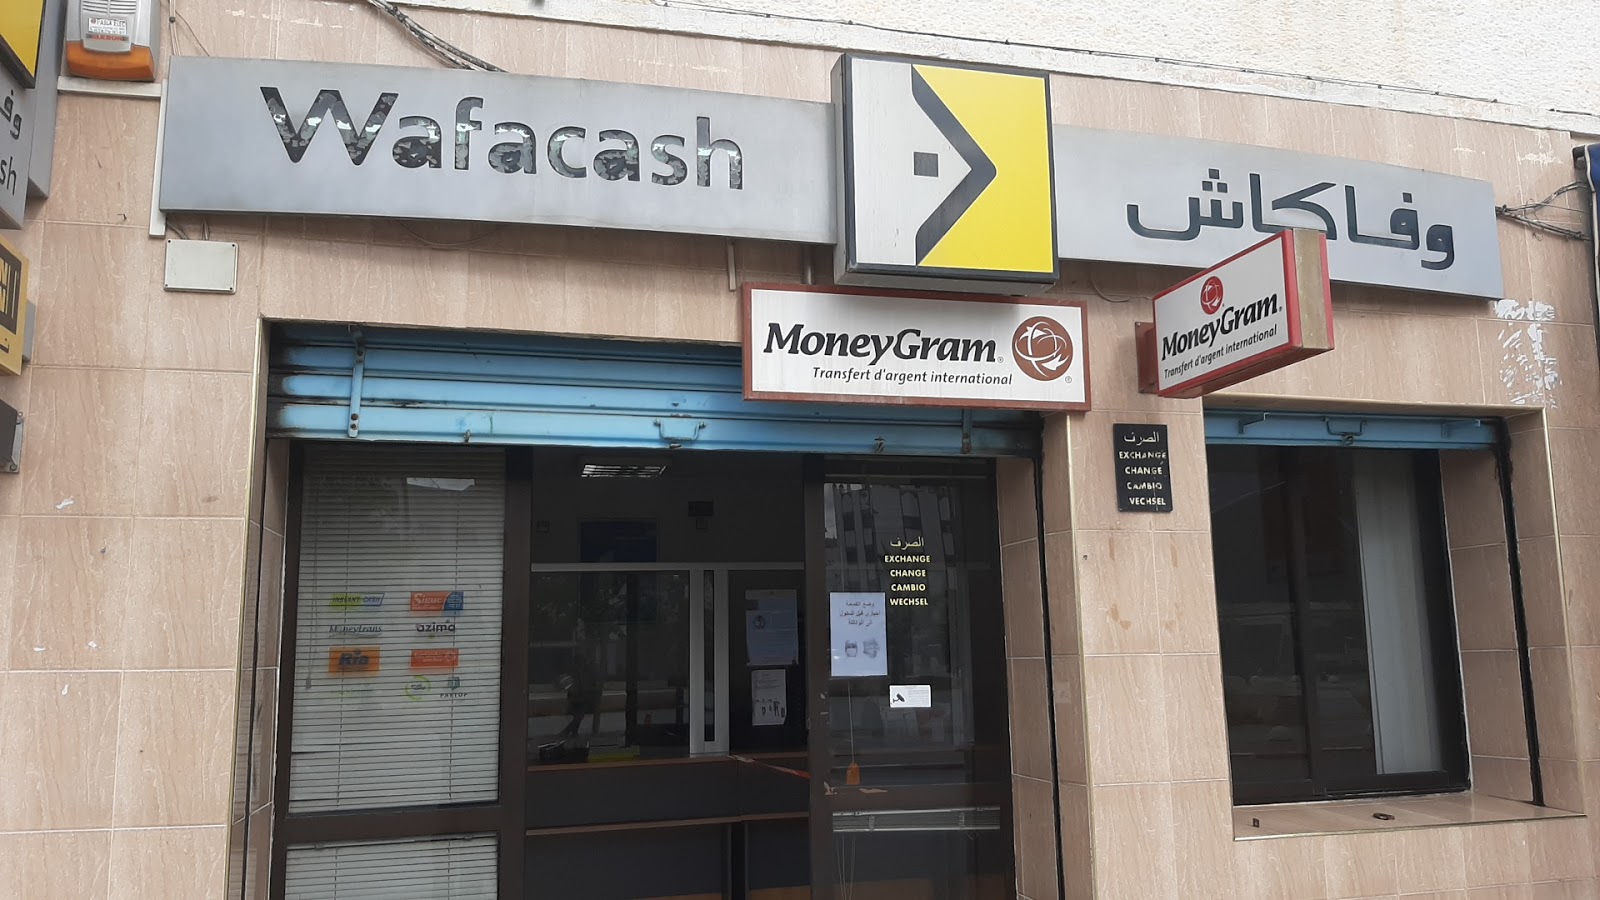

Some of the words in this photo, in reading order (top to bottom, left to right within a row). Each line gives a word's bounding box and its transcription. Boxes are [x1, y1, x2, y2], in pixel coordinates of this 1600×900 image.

[259, 86, 744, 190] Wafacash
[1126, 168, 1456, 271] وفاكاش
[1161, 293, 1278, 362] MoneyGram
[763, 322, 997, 366] MoneyGram
[1163, 361, 1194, 380] Transfert
[1194, 344, 1225, 367] d'argent
[1225, 323, 1277, 354] international
[812, 366, 871, 383] Transfert
[874, 368, 928, 385] d'argent
[930, 372, 1013, 386] international
[1123, 431, 1160, 446] الصرف
[1118, 450, 1167, 460] EXCHANGE
[1124, 466, 1163, 475] CHANGE
[1126, 481, 1163, 490] CAMBIO
[889, 536, 925, 550] الصرف
[884, 555, 931, 563] EXCHANGE
[889, 569, 926, 578] CHANGE
[890, 583, 926, 592] CAMBIO
[889, 597, 929, 606] WECHSEL
[416, 621, 456, 632] azimo
